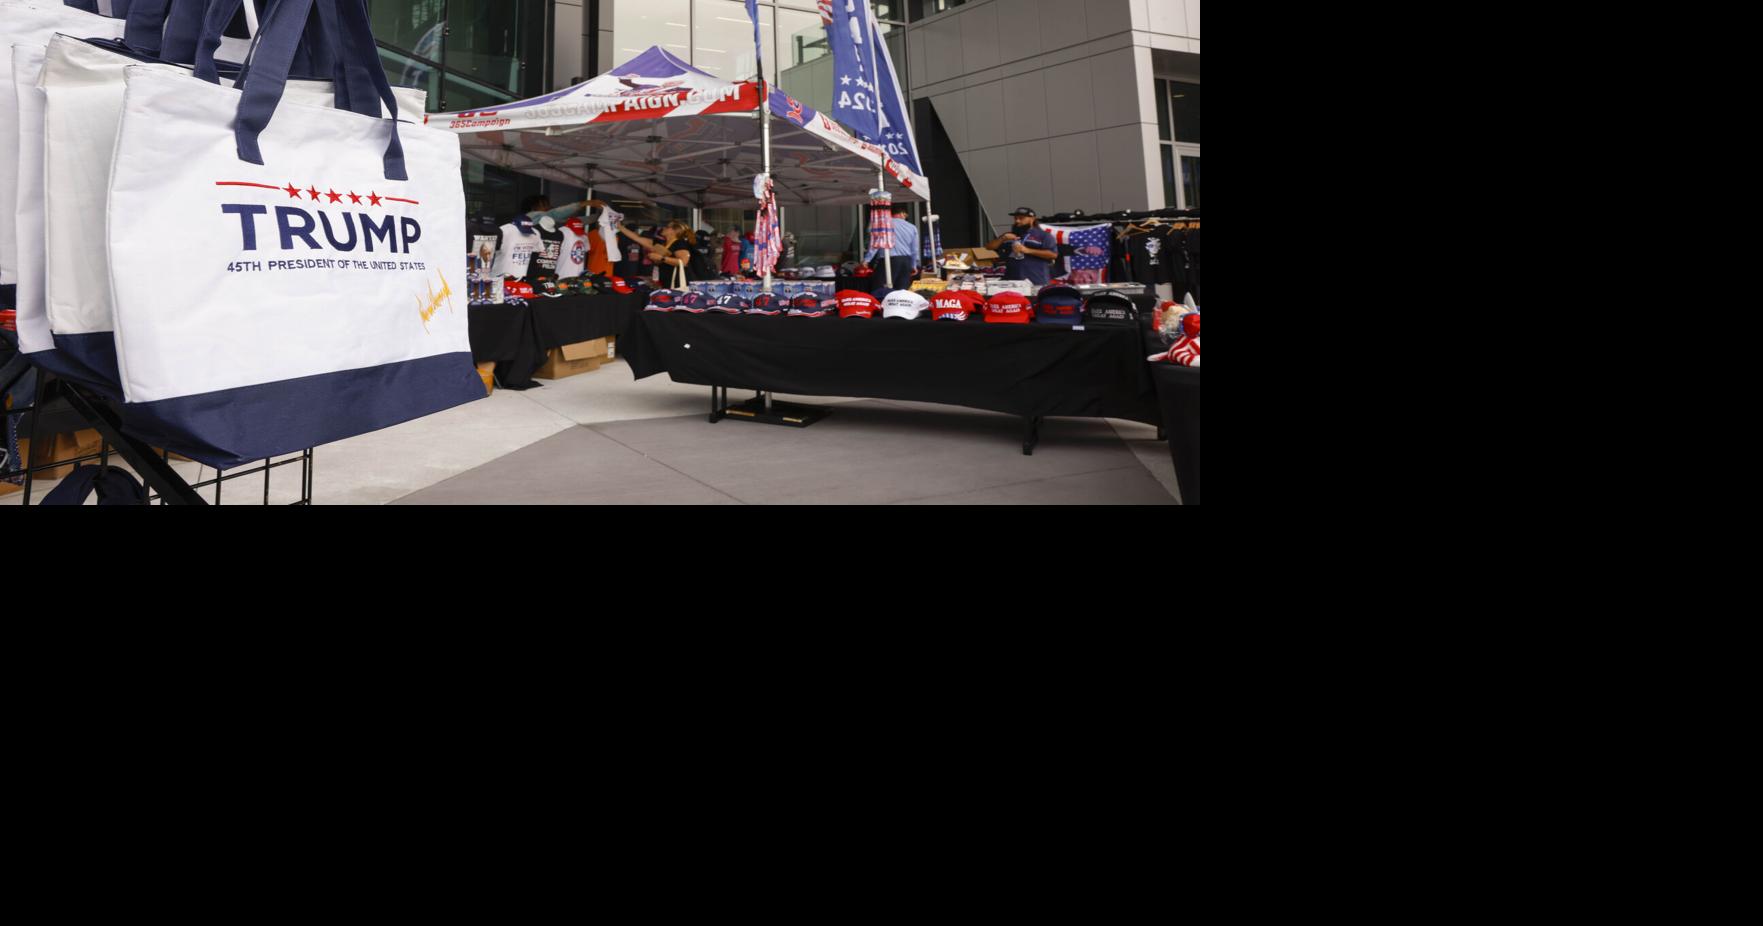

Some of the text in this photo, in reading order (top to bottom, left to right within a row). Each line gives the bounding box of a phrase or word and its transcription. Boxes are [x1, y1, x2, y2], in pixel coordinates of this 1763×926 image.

[449, 117, 511, 129] 365Campaign
[221, 204, 421, 254] TRUMP
[227, 259, 426, 272] 45TH PRESIDENT OF THE UNITED STATES
[936, 299, 962, 309] MAGA
